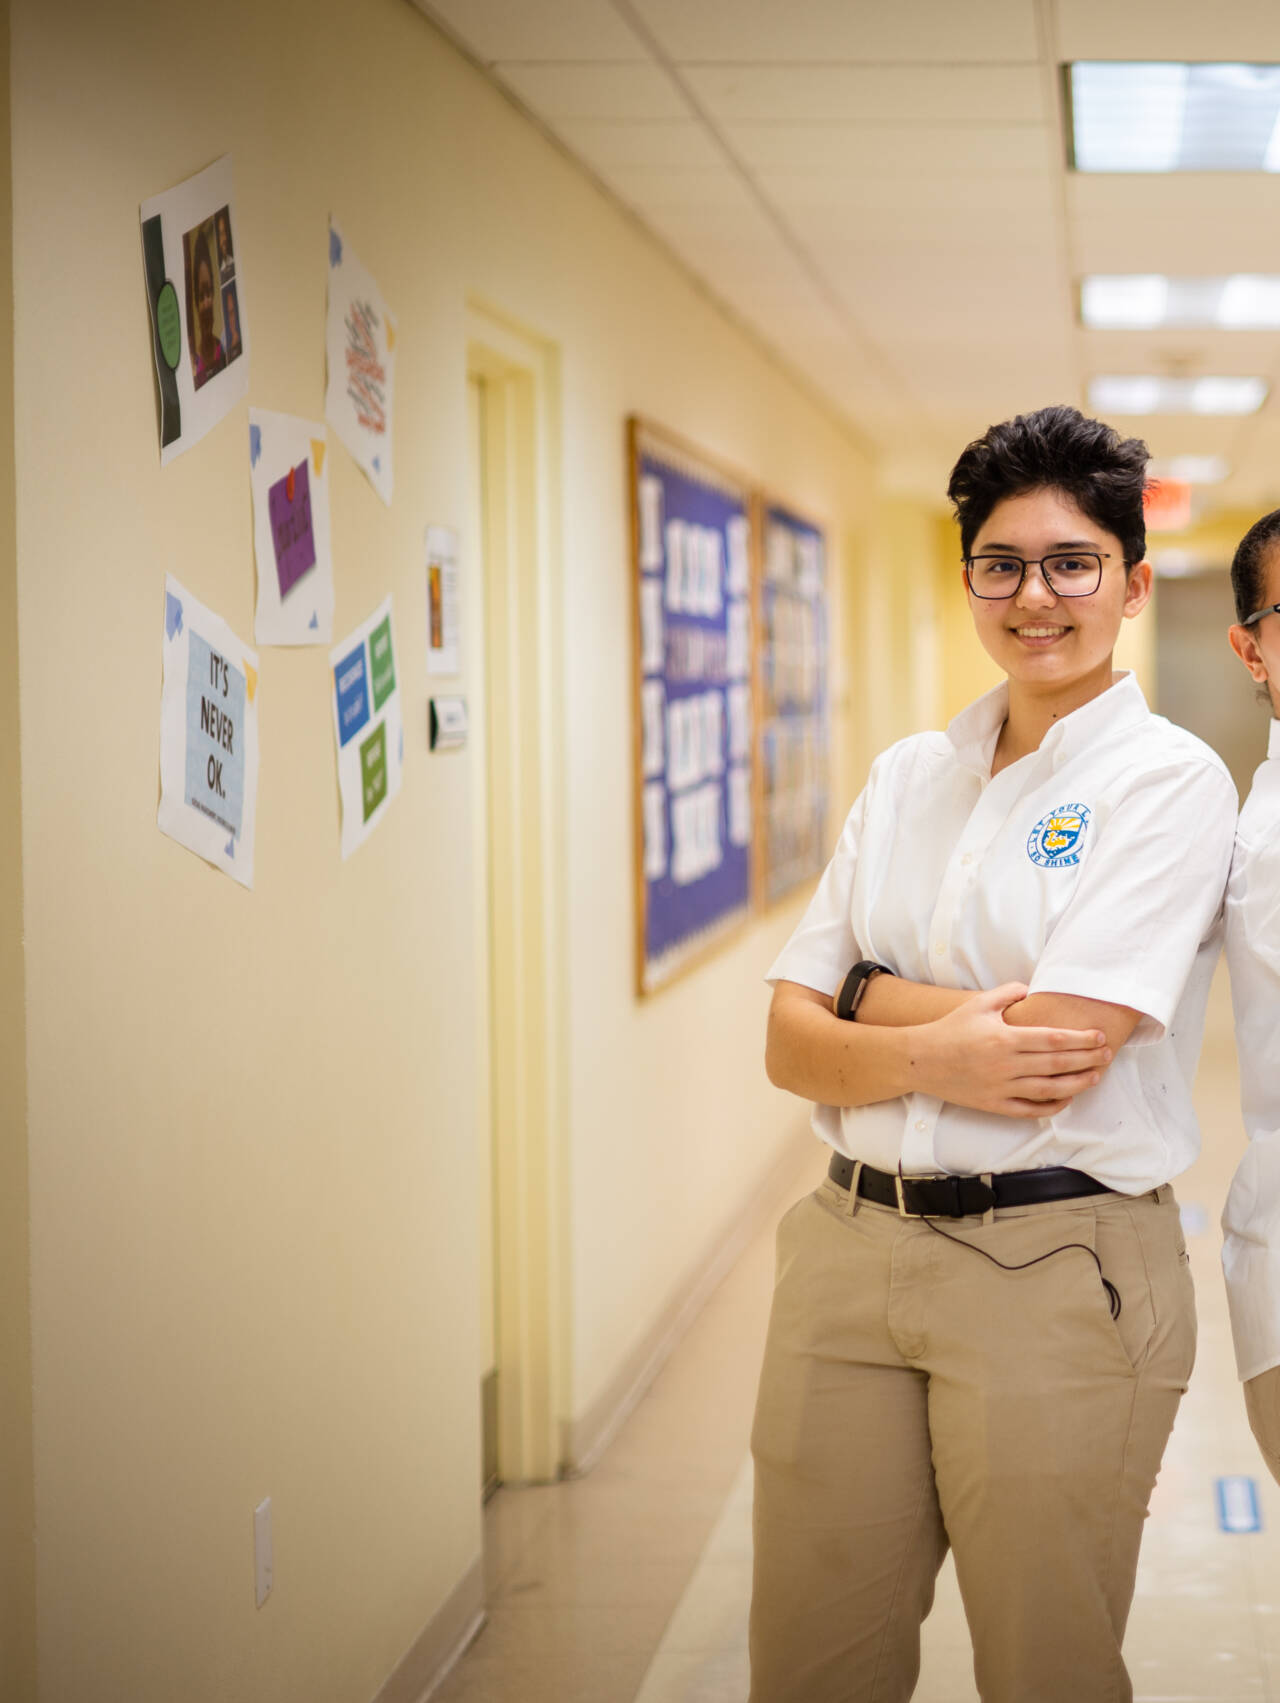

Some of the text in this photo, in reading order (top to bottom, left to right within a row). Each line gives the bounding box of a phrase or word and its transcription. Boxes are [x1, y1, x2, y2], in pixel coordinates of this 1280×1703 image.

[209, 651, 229, 699] IT'S
[200, 695, 234, 755] NEVER
[206, 753, 226, 800] OK.
[1044, 853, 1080, 866] SHINE
